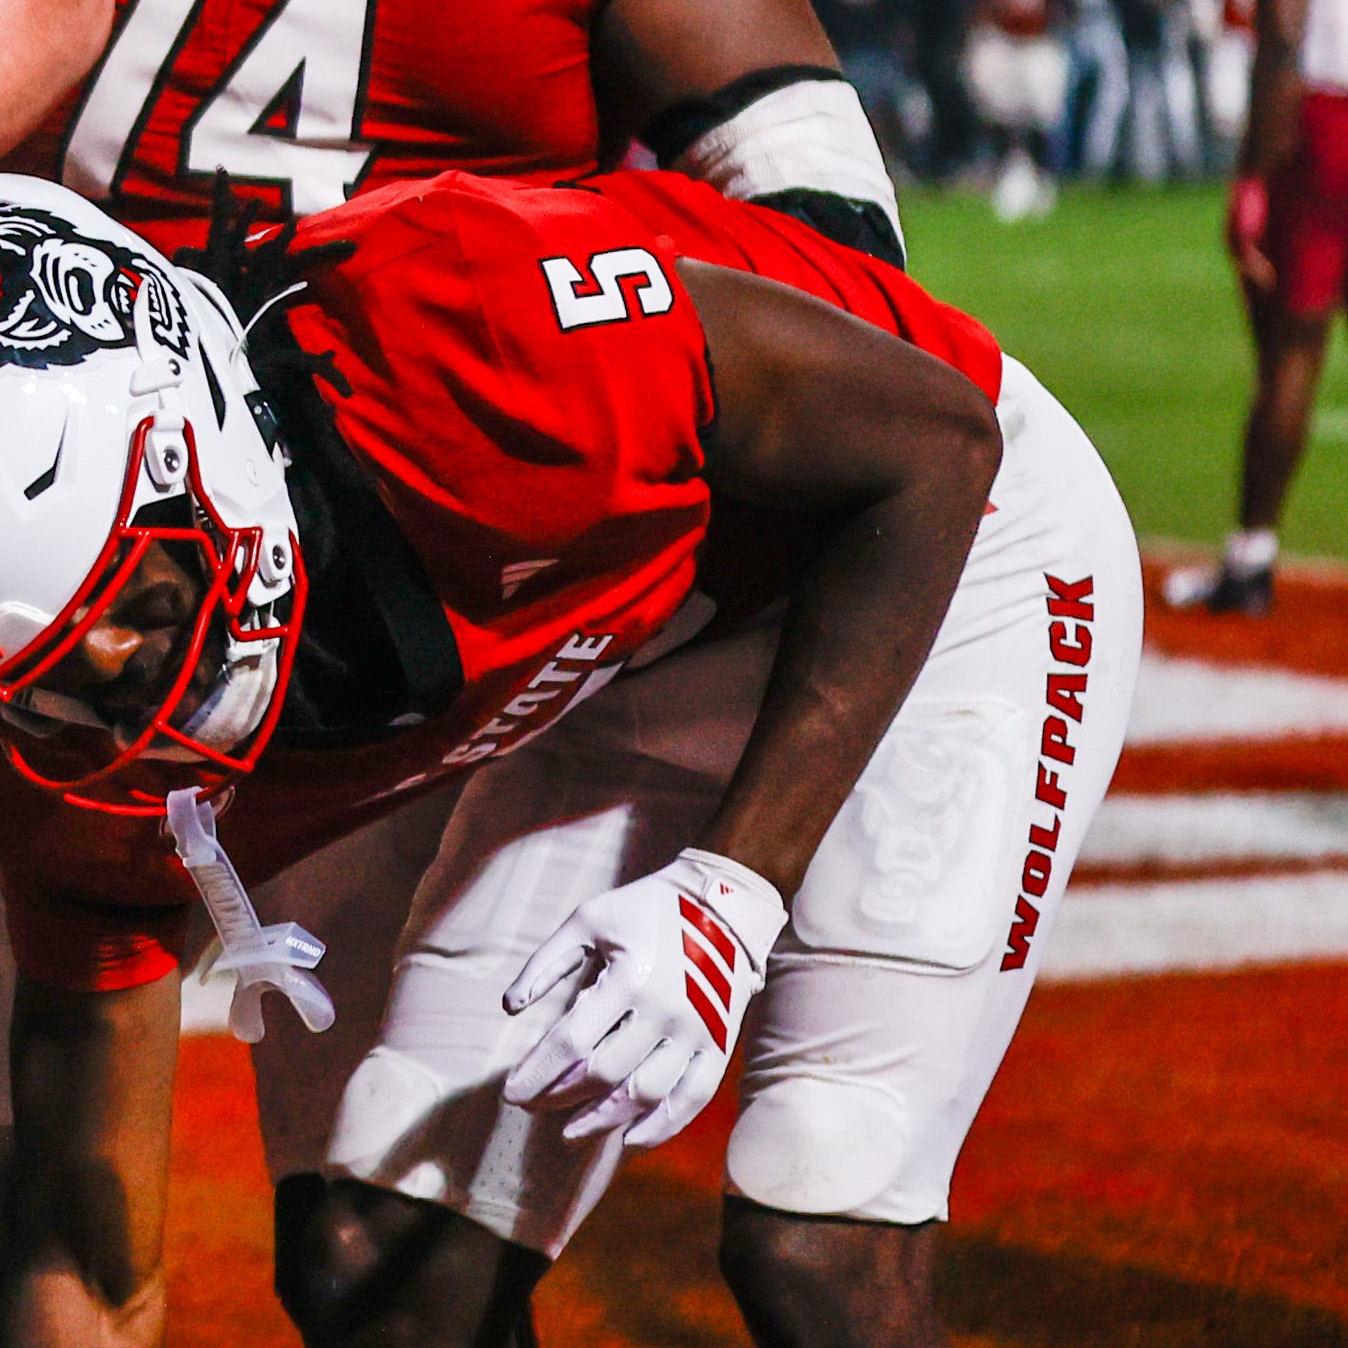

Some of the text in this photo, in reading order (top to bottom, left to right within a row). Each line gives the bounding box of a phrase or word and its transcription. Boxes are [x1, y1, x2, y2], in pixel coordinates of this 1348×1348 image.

[540, 246, 675, 333] 5
[999, 571, 1095, 973] WOLFPACK
[284, 936, 321, 958] NXTRND
